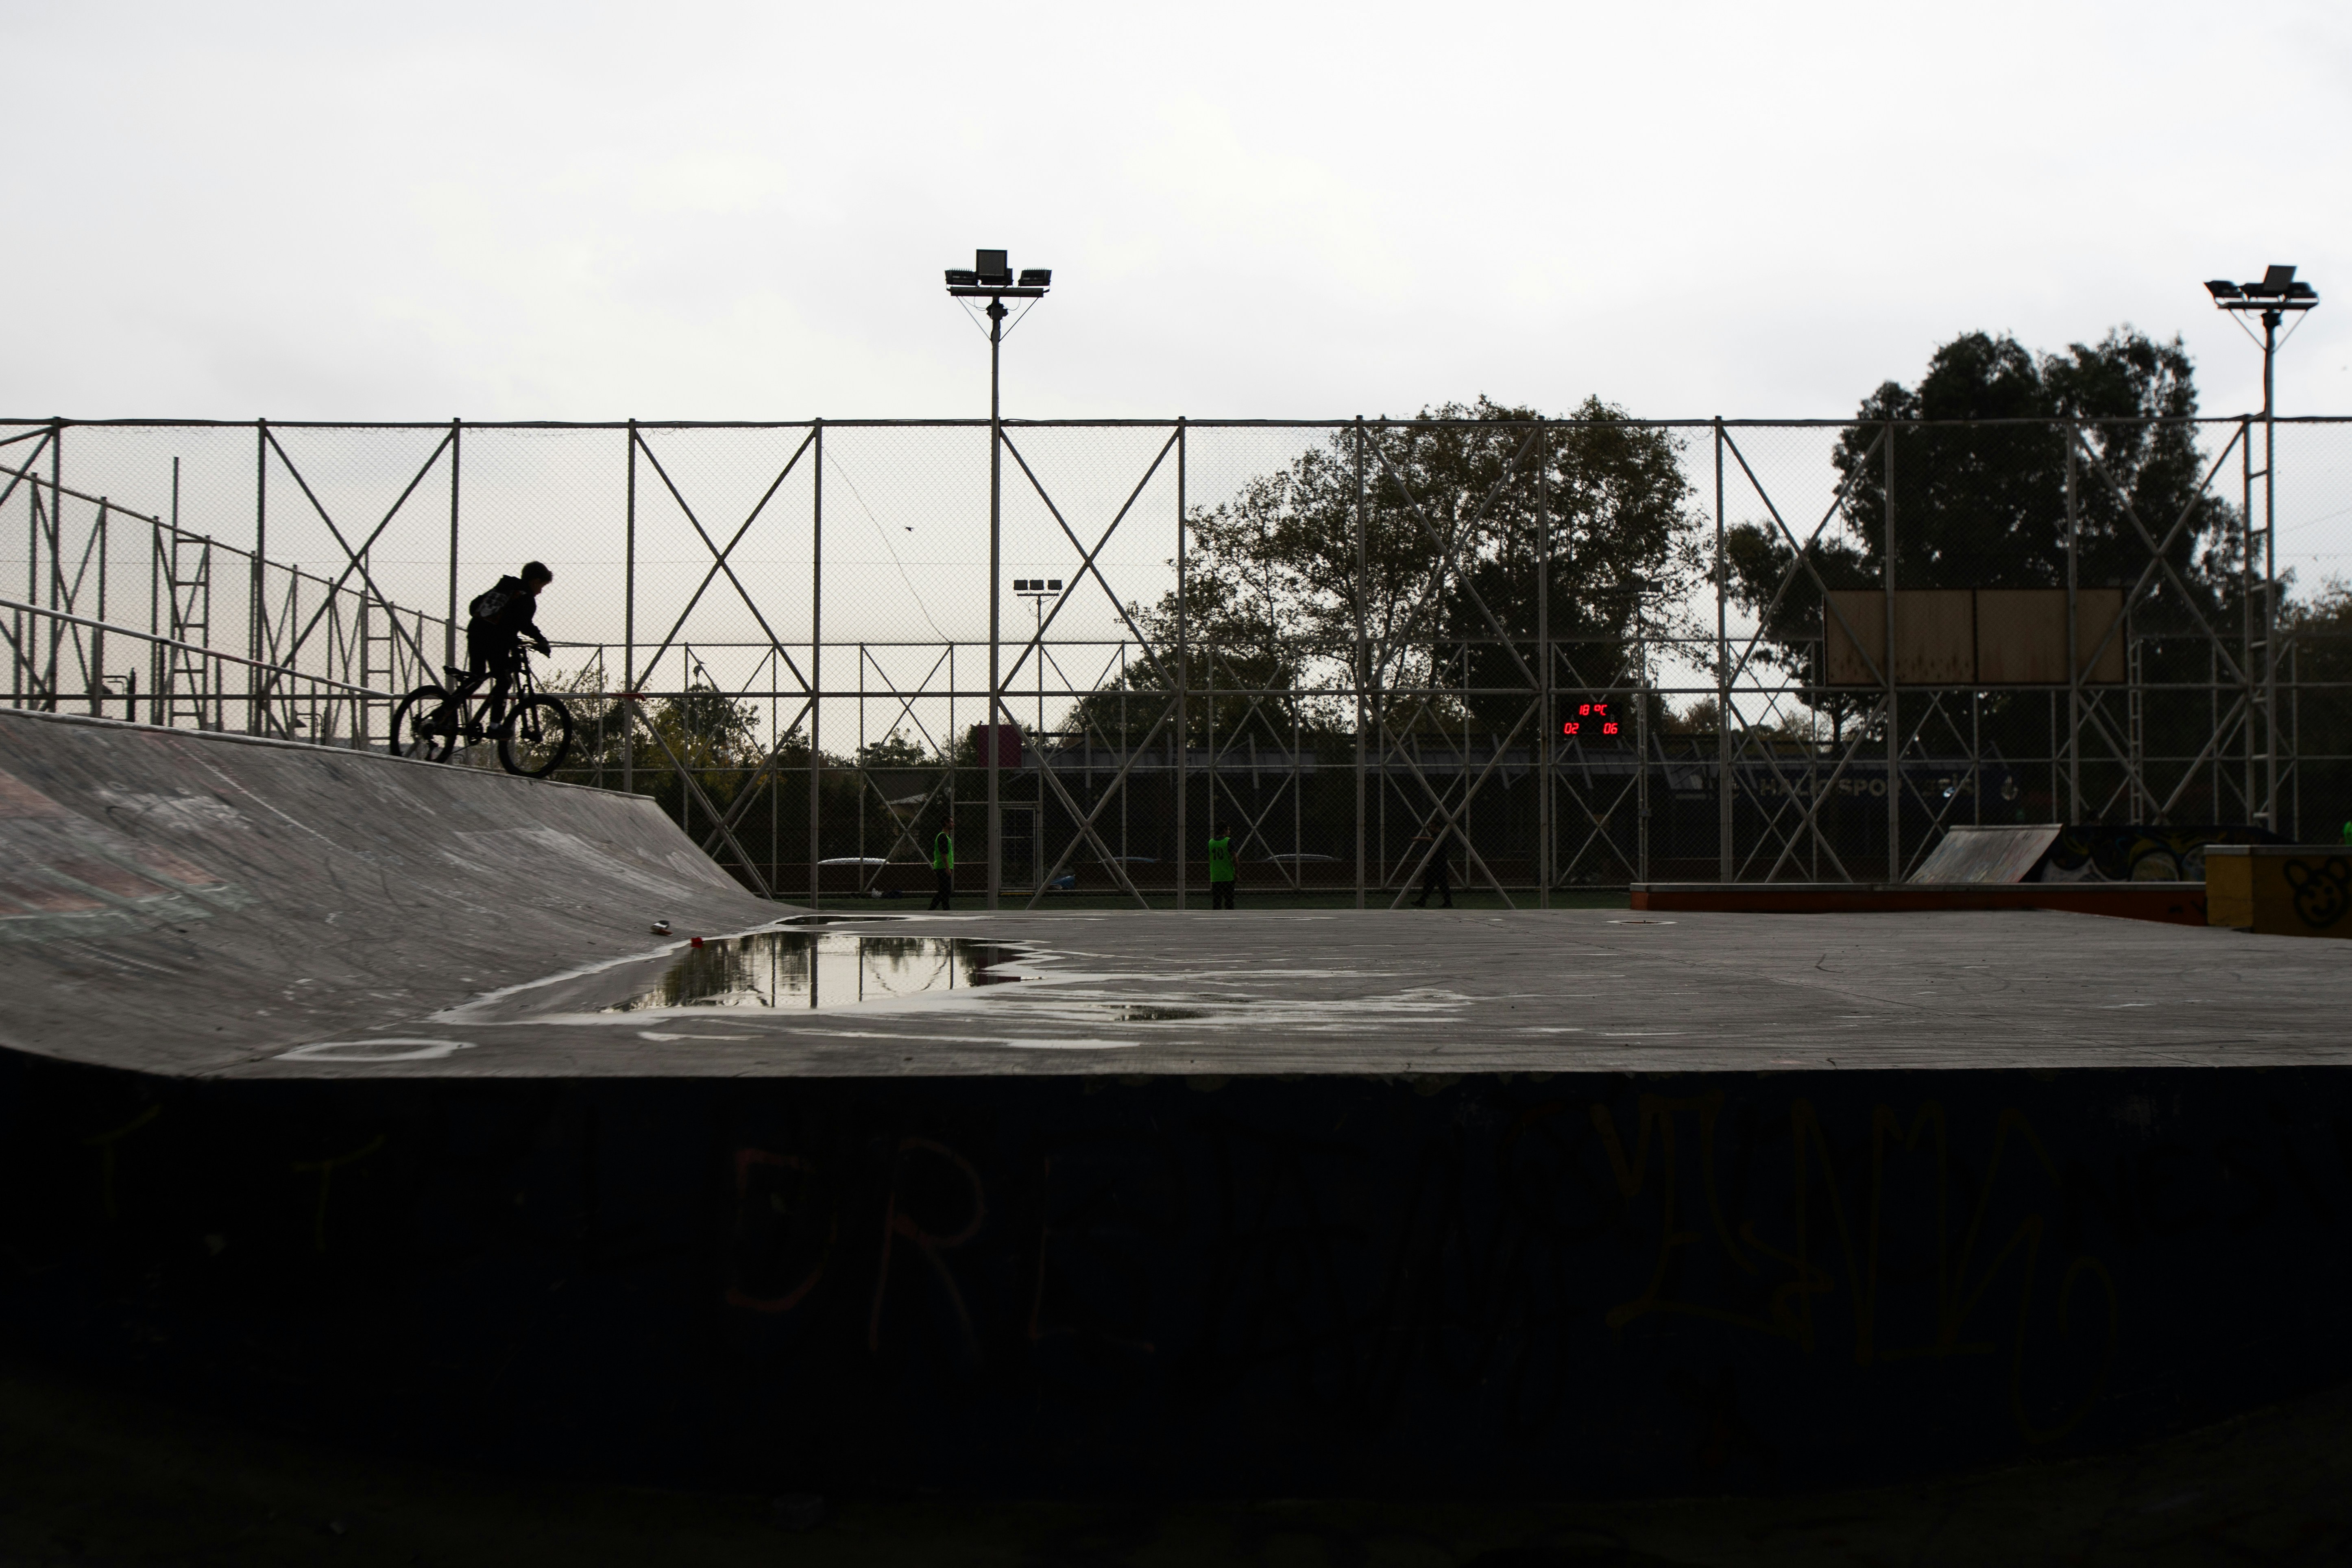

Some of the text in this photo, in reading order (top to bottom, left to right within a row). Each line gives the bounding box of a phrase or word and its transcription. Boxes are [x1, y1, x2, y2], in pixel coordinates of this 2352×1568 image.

[1579, 703, 1591, 716] 18
[1563, 722, 1580, 735] 02
[1602, 722, 1619, 735] 06
[1212, 846, 1224, 860] 10
